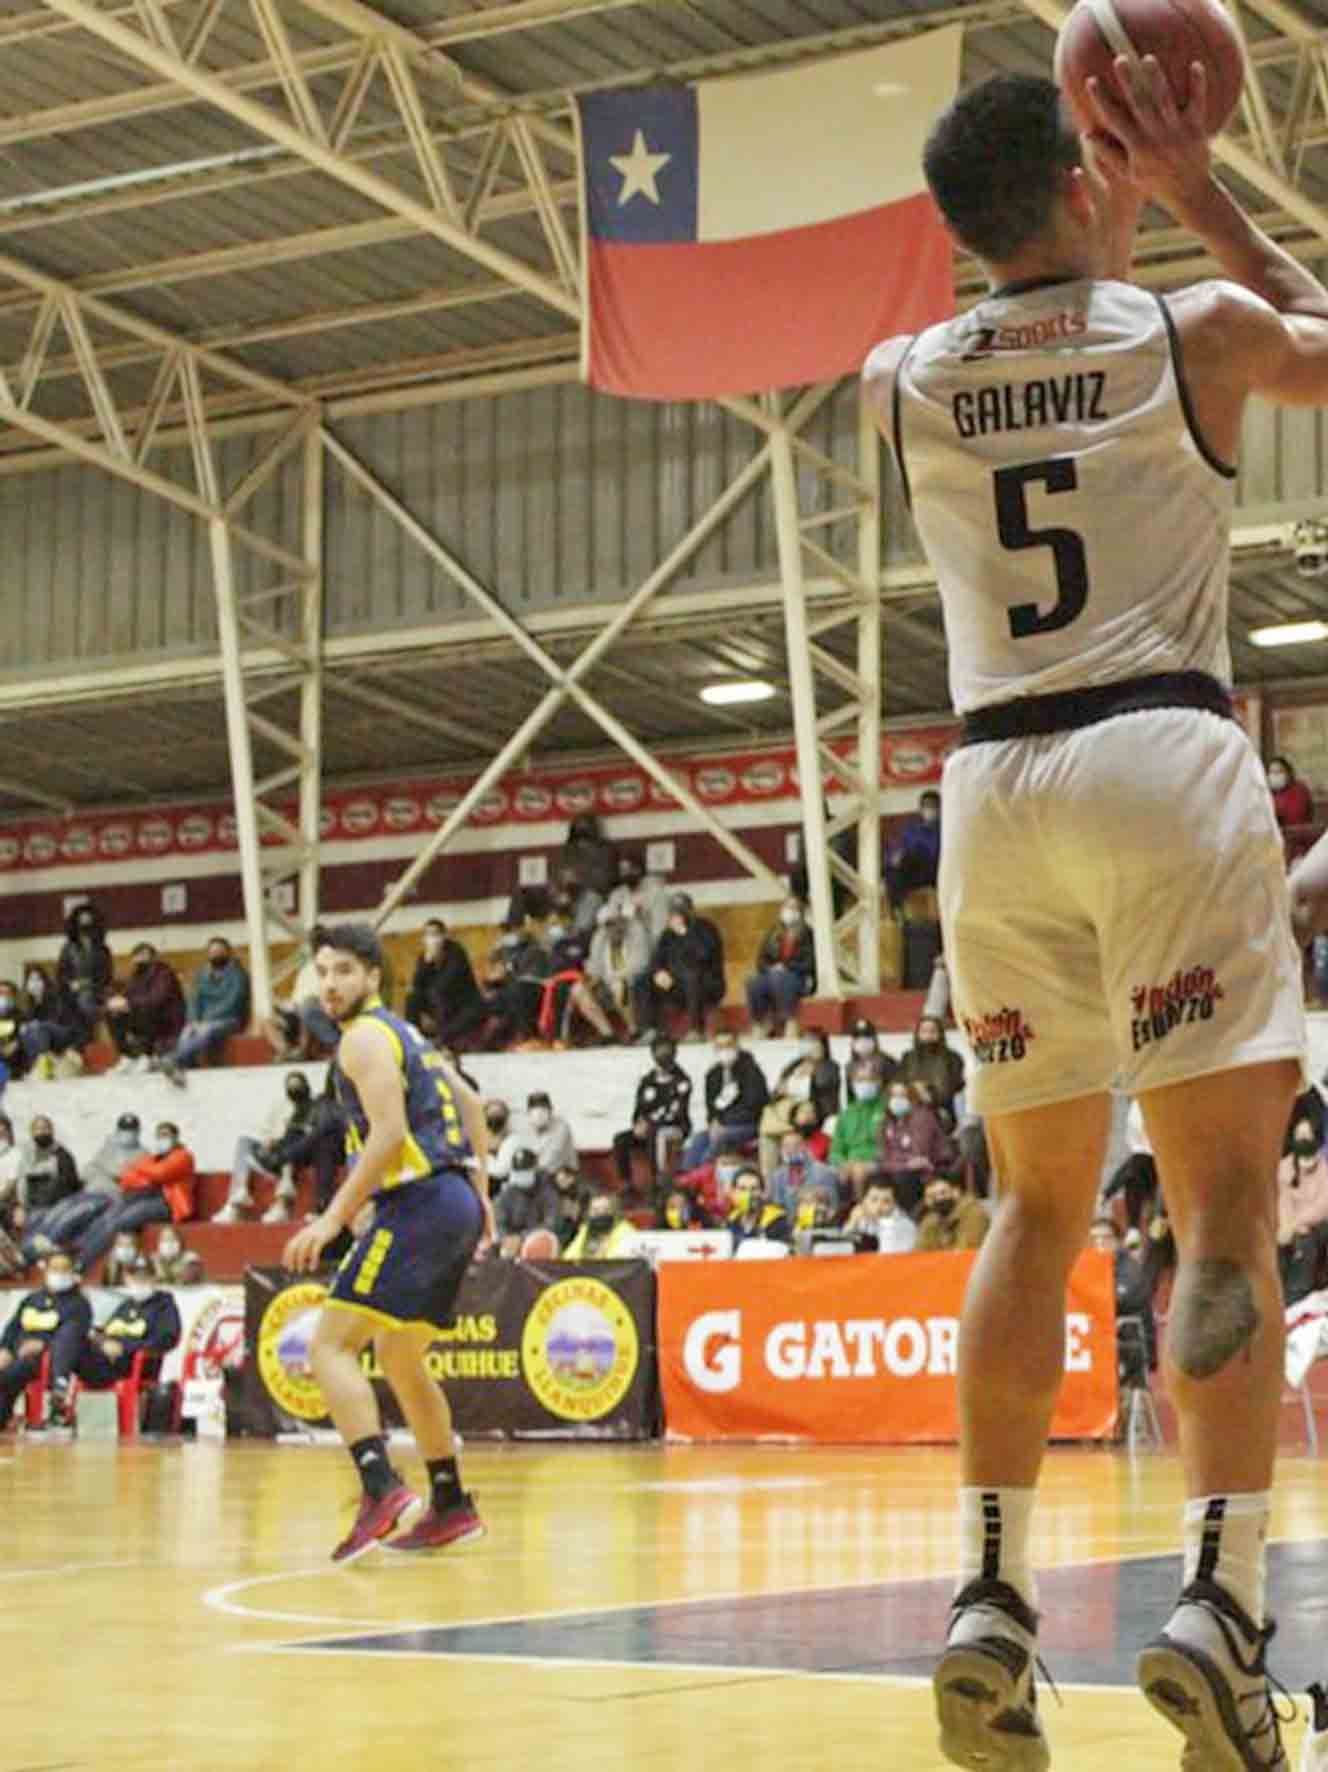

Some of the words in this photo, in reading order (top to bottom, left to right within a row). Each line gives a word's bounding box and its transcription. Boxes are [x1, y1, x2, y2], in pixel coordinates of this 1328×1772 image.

[952, 370, 1108, 439] GALAVIZ
[993, 457, 1089, 640] 5
[361, 1351, 520, 1382] LQUIHUE
[682, 1309, 742, 1394] G
[764, 1312, 1092, 1380] GATORE
